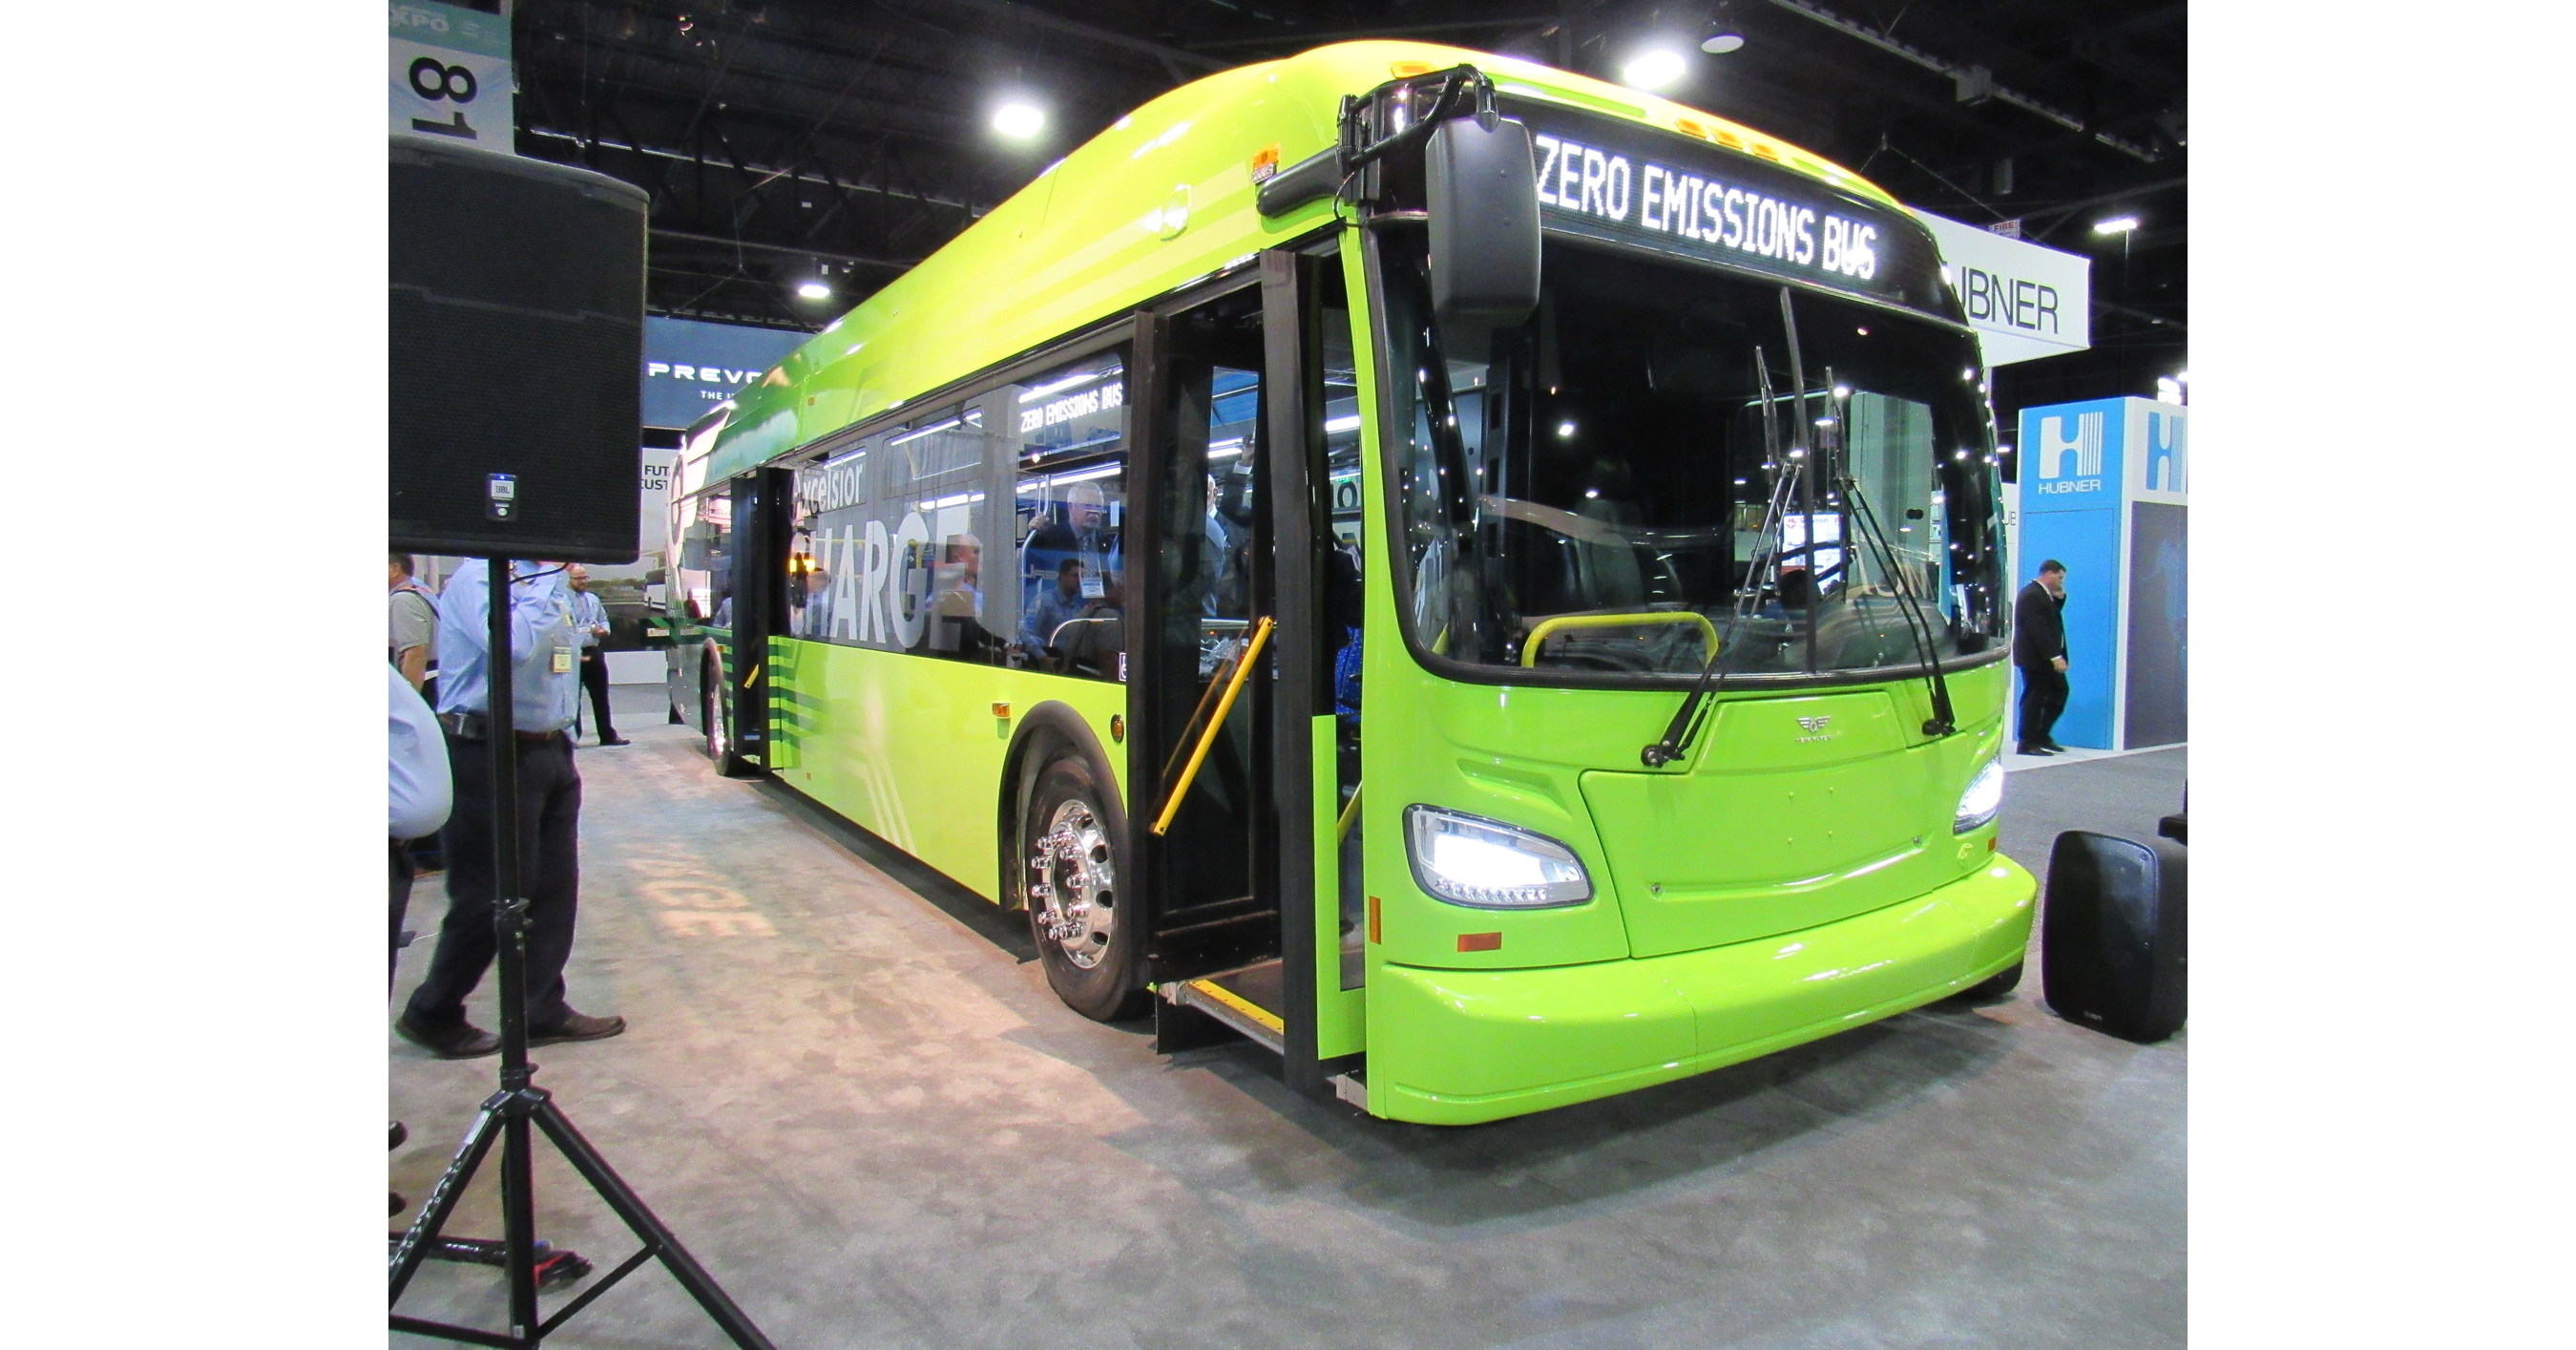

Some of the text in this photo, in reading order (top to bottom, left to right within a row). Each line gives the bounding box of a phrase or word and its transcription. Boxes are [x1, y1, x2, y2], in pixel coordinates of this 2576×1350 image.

[389, 8, 450, 32] XPO
[408, 56, 477, 140] 81
[1536, 134, 1879, 281] ZERO EMISSIONS BUS
[701, 390, 723, 400] THE
[1020, 382, 1124, 432] ZERO EMISSIONS BUS
[644, 465, 670, 476] FUT
